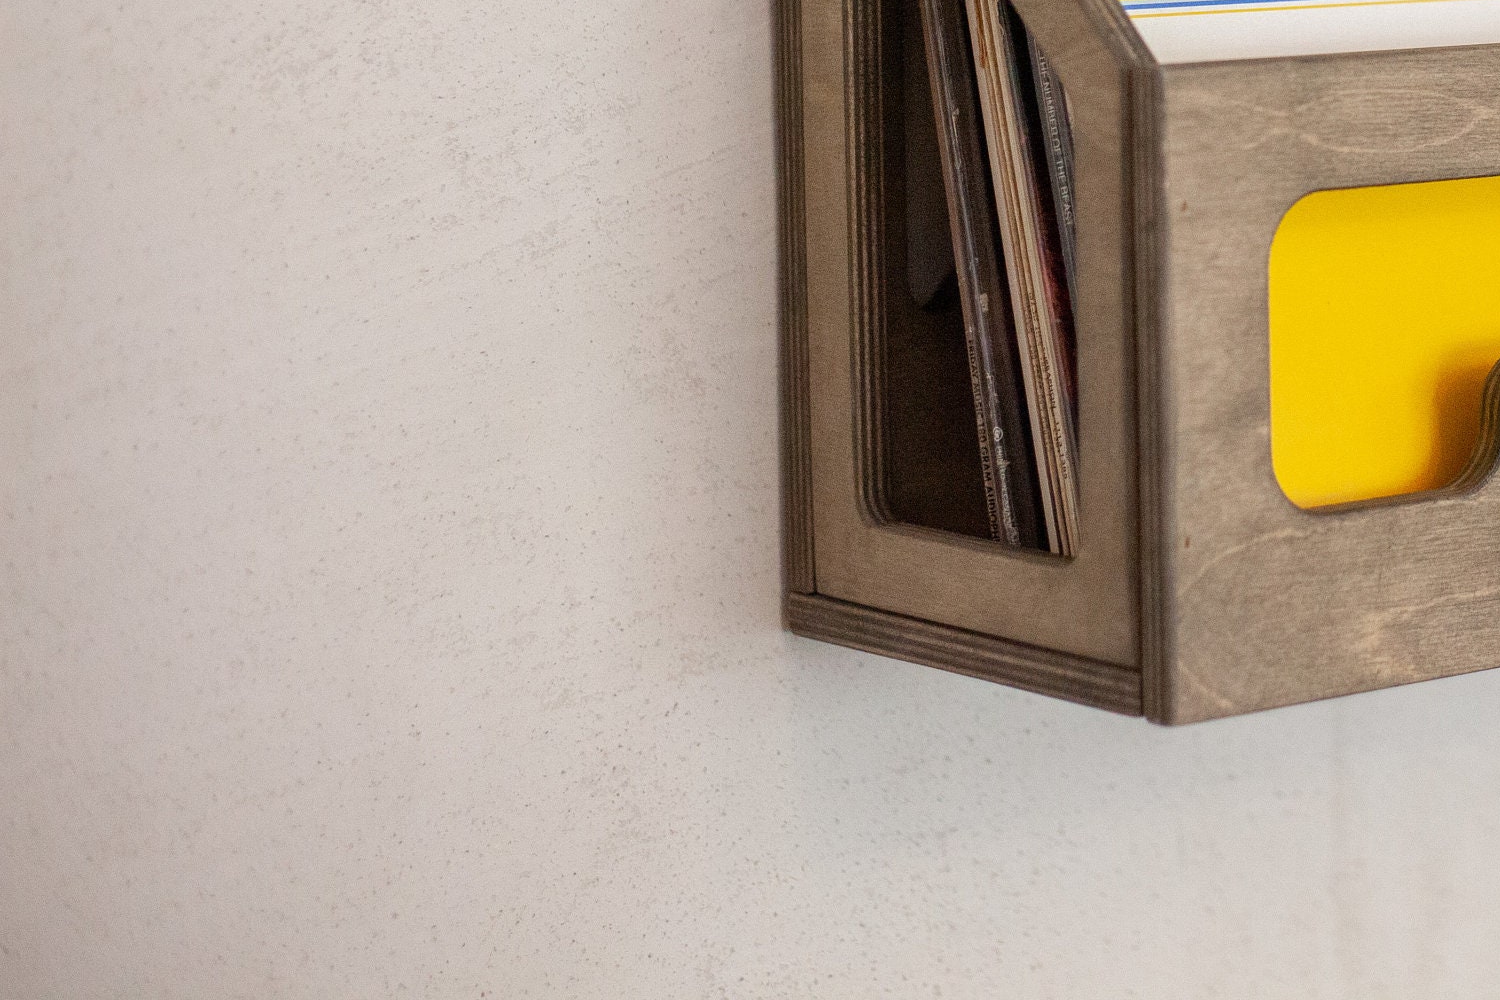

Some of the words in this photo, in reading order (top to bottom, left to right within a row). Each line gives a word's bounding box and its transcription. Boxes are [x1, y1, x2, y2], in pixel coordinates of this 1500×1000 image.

[1041, 81, 1058, 136] NUMBER
[1052, 137, 1061, 154] OF
[1055, 159, 1065, 180] THE
[1059, 185, 1073, 226] BEAST
[980, 446, 991, 481] GRAM
